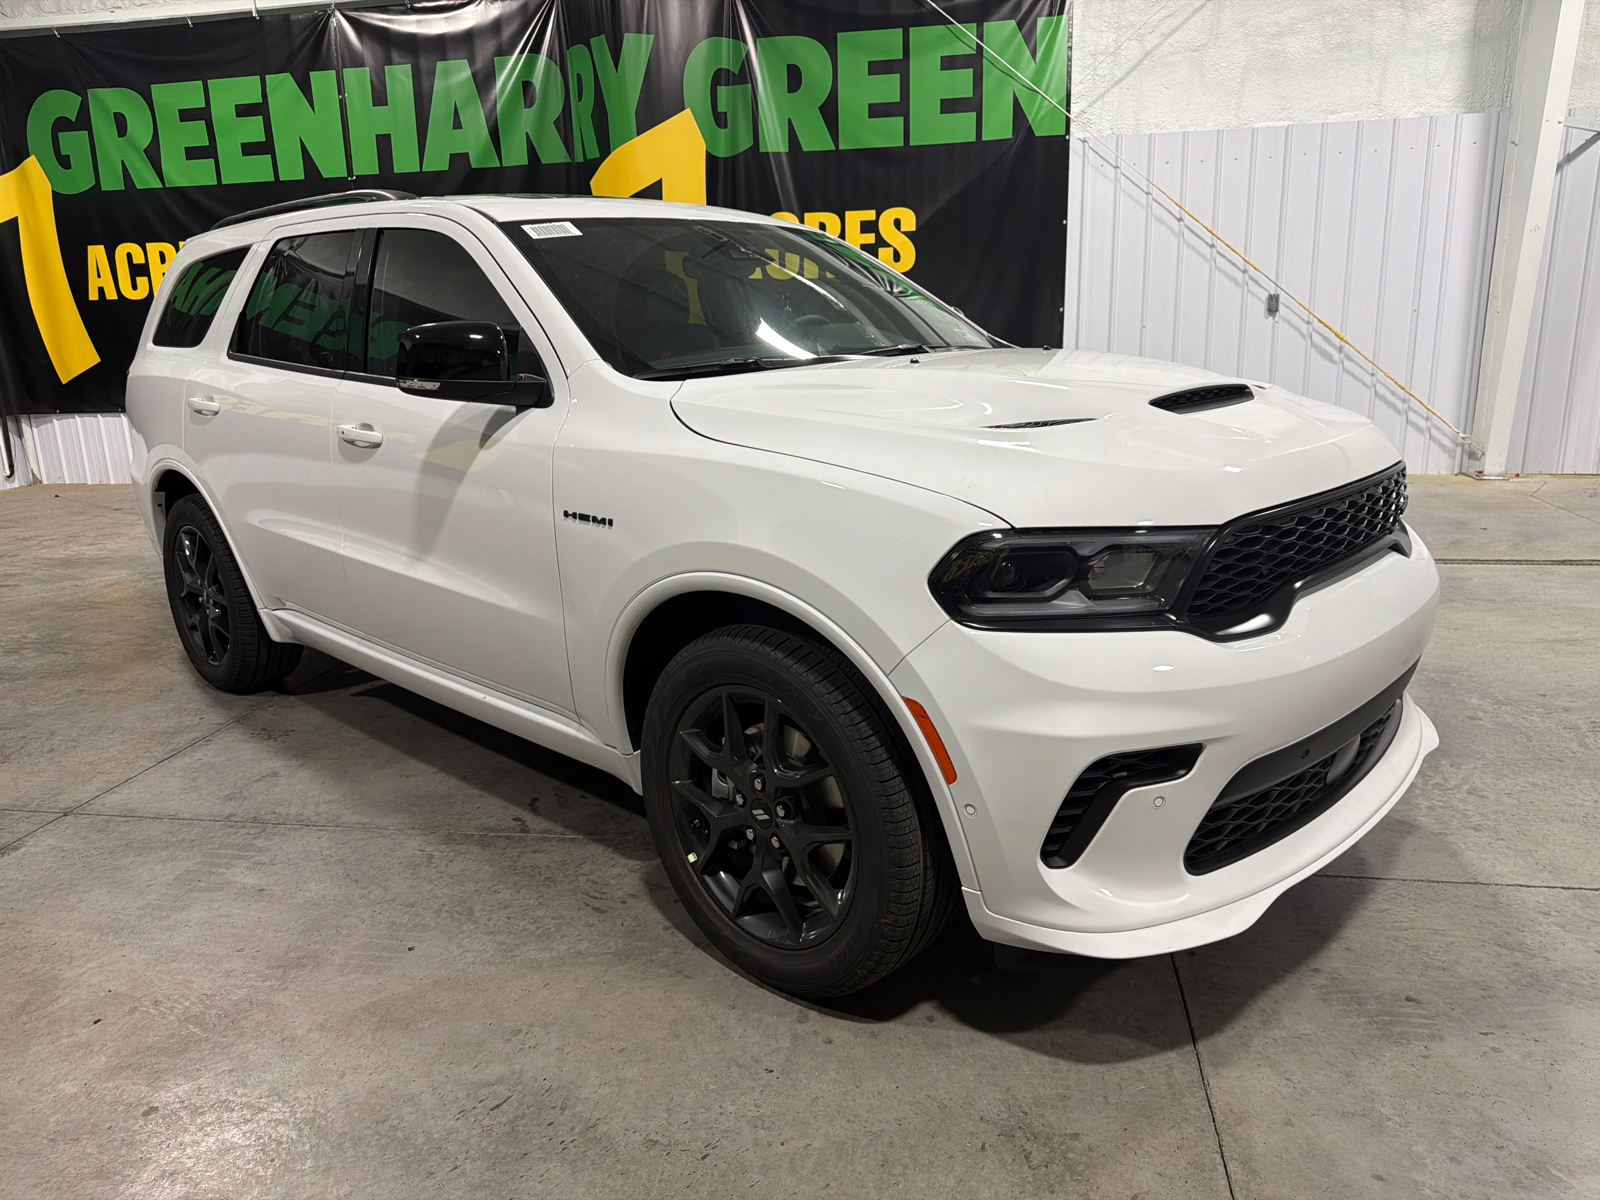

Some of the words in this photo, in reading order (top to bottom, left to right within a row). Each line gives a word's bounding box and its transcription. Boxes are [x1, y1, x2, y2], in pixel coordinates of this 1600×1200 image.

[683, 15, 1069, 158] GREEN
[87, 242, 188, 301] ACR
[563, 509, 613, 527] HEMI
